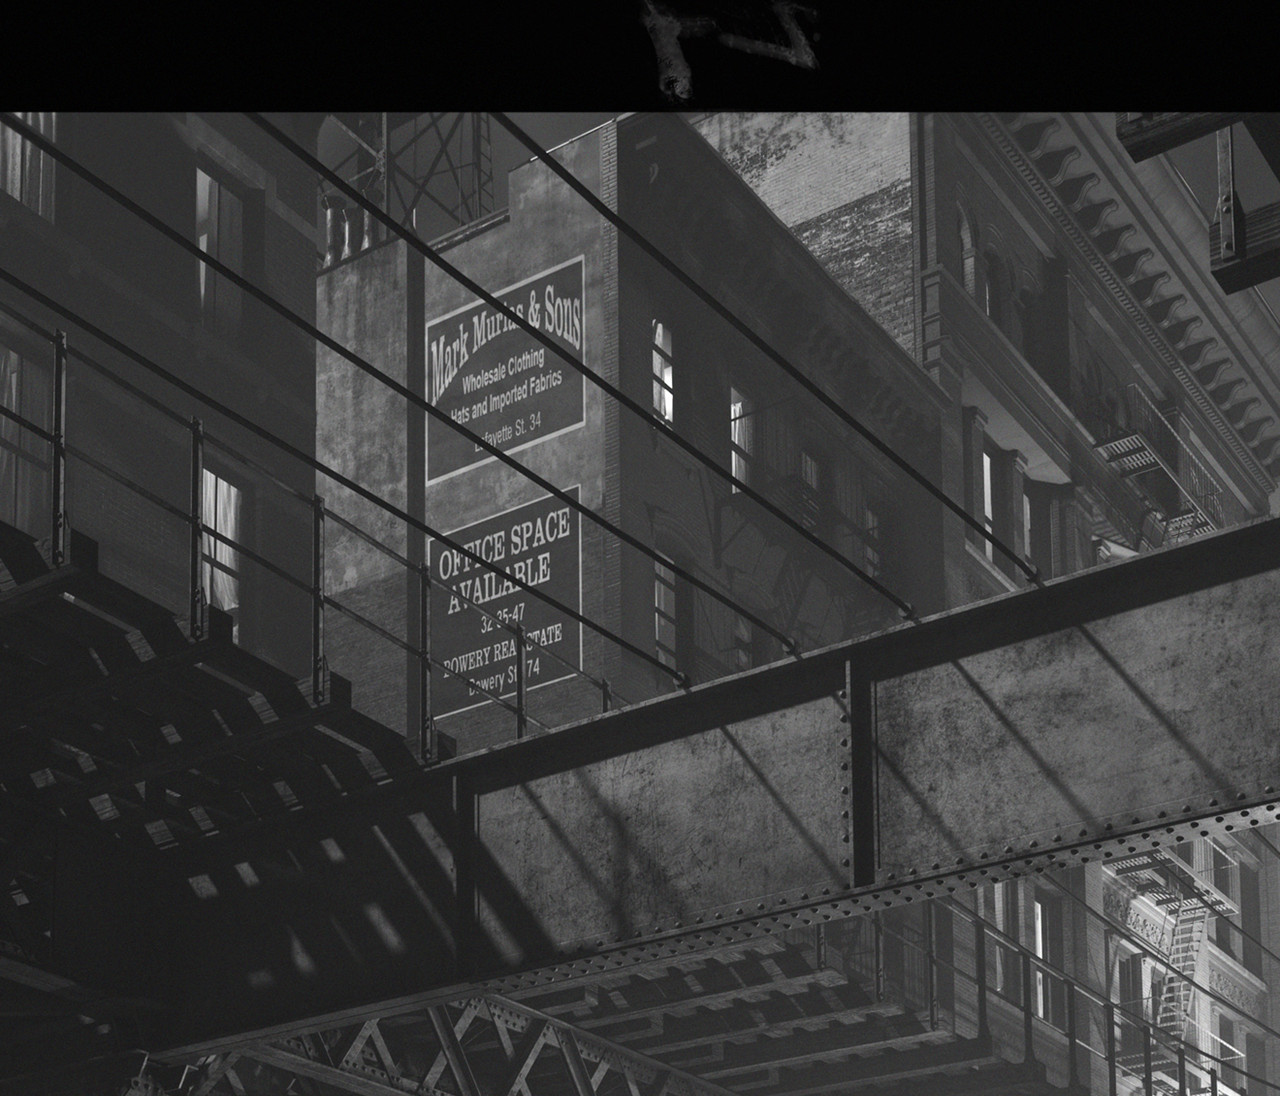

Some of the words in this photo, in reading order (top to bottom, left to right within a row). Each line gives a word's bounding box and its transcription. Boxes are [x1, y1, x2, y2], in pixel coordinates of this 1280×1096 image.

[431, 323, 469, 407] Mark
[528, 289, 541, 330] &
[545, 284, 581, 351] Sons
[462, 363, 507, 395] Wholesale
[508, 347, 545, 377] Clothing
[451, 409, 470, 425] Hats
[472, 396, 488, 418] and
[490, 380, 528, 413] Imported
[530, 370, 563, 396] Fabrics
[515, 420, 527, 436] St.
[529, 411, 542, 431] 34
[510, 506, 571, 556] SPACE
[448, 552, 551, 615] AVAILABLE
[493, 638, 517, 664] REA
